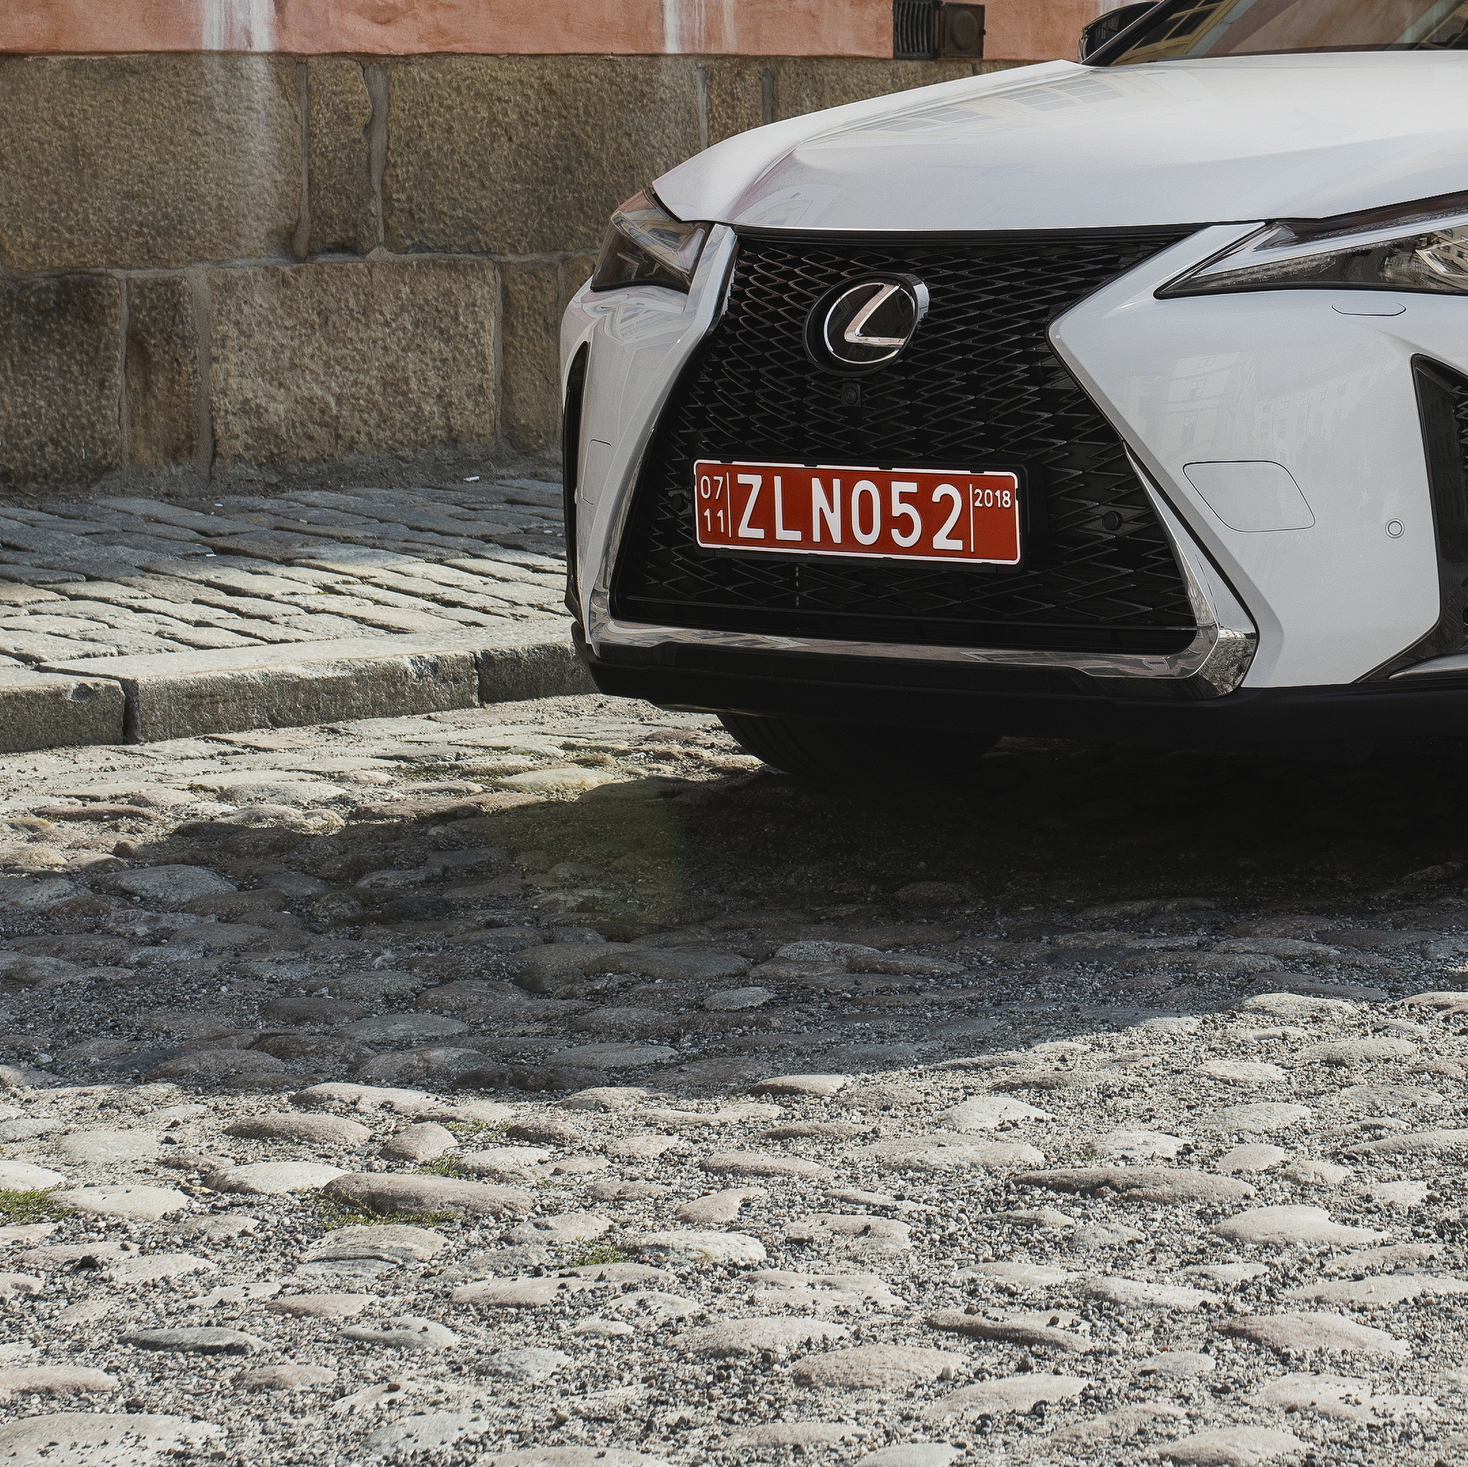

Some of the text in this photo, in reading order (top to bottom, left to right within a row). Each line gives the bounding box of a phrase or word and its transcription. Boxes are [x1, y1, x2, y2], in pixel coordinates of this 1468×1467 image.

[700, 475, 724, 500] 07
[973, 488, 1012, 508] 2018
[703, 508, 724, 533] 11
[737, 473, 963, 551] ZLN052
